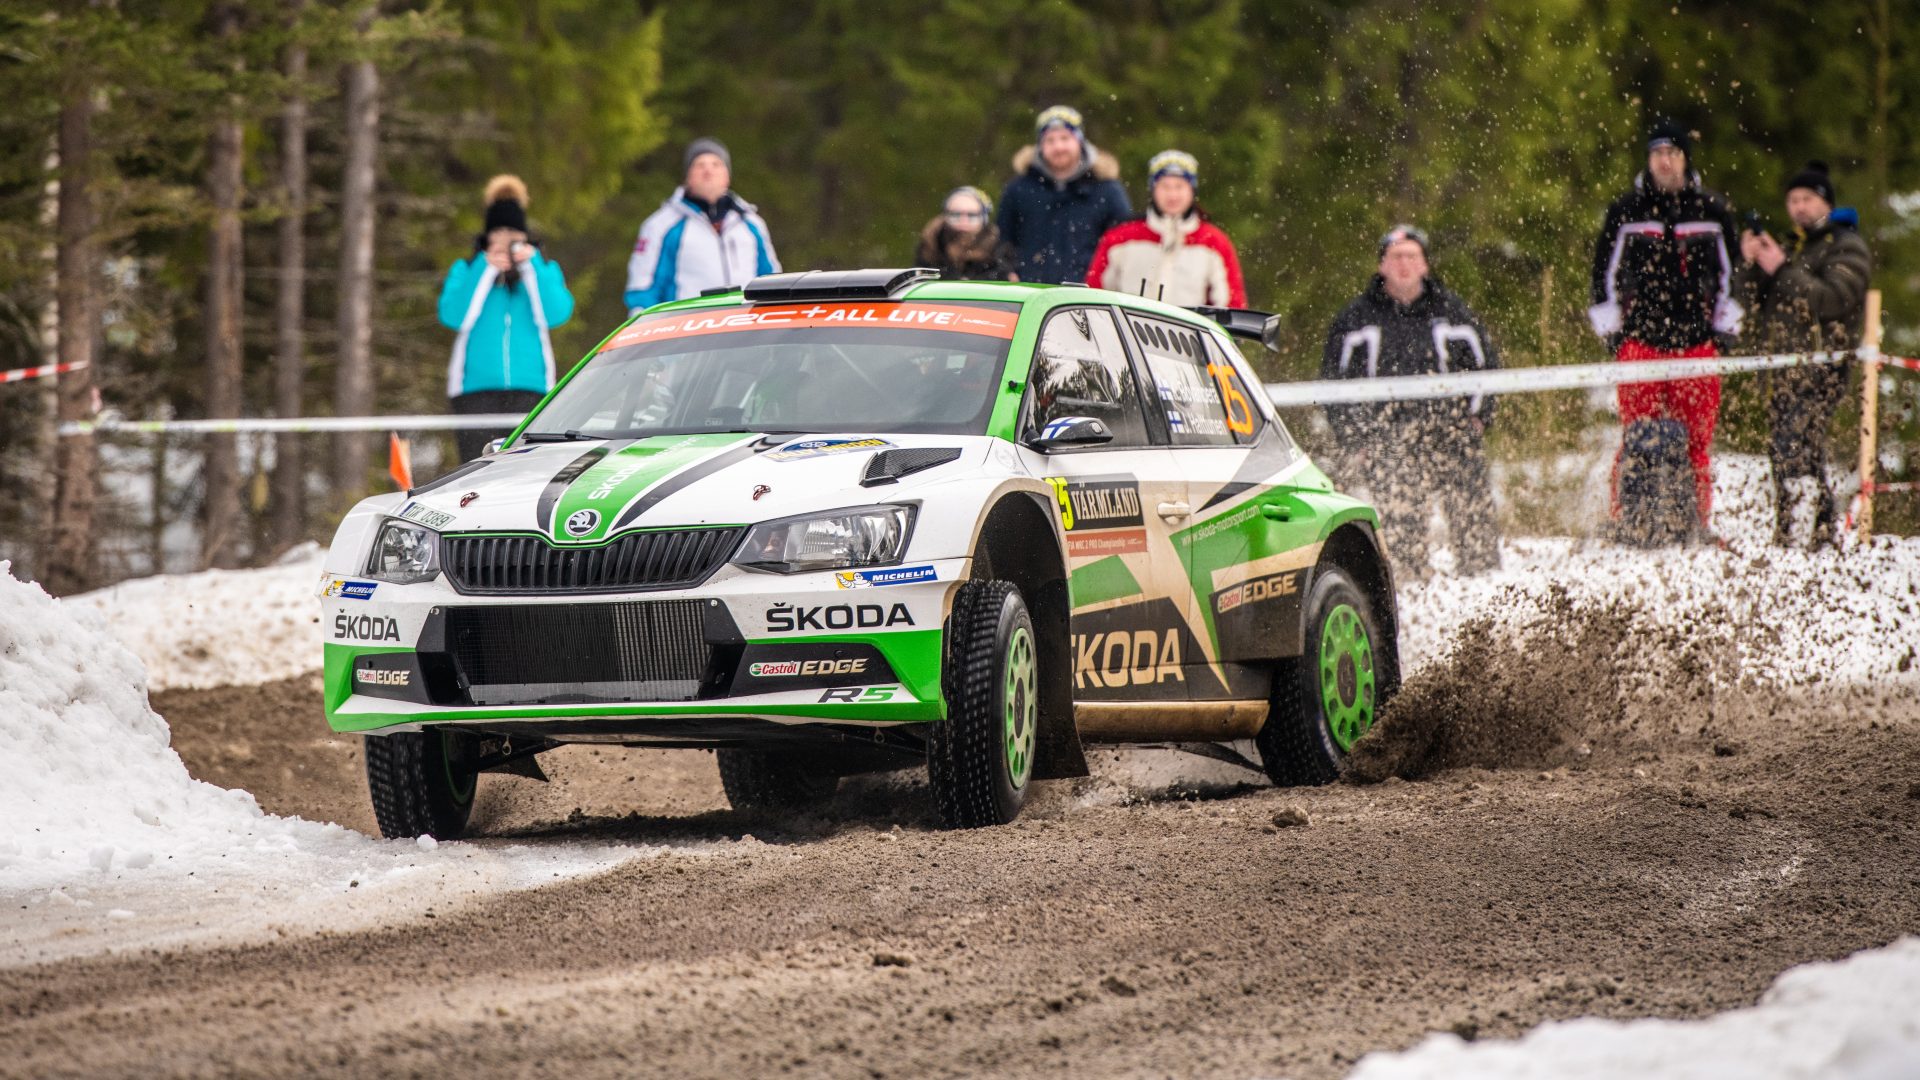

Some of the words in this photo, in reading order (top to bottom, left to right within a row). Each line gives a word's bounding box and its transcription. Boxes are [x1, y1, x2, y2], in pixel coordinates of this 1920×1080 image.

[825, 309, 879, 321] ALL
[888, 311, 955, 325] LIVE
[1070, 482, 1140, 520] VÄRMLAND
[421, 511, 450, 527] 0389
[872, 569, 934, 581] MICHELIN
[345, 586, 376, 594] MICHELIN
[1243, 571, 1298, 604] EDGE
[334, 608, 400, 641] ŠKODA
[766, 602, 915, 632] ŠKODA
[761, 662, 797, 675] Castrol
[800, 658, 870, 675] EDGE
[1071, 628, 1184, 689] KODA
[377, 670, 411, 685] EDGE
[818, 687, 898, 703] R5
